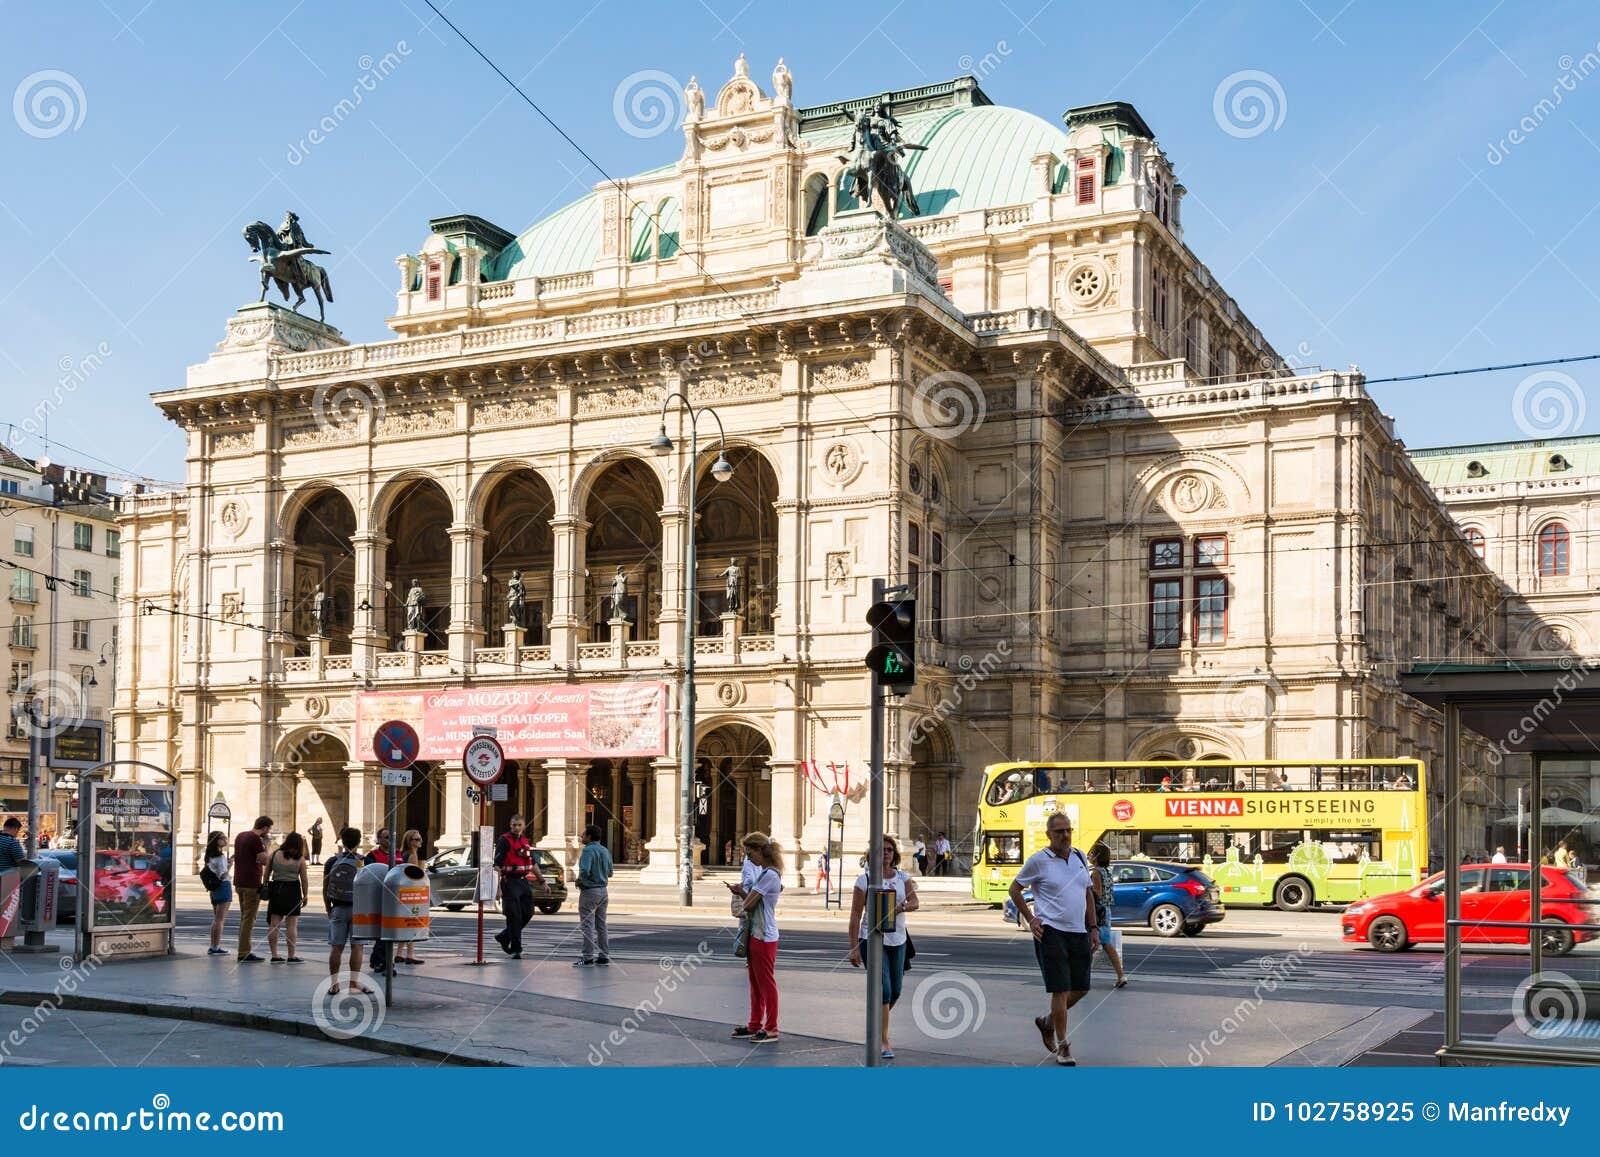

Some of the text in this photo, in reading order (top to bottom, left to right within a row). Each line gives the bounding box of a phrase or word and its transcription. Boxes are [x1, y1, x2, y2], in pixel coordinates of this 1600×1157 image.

[467, 692, 532, 706] MOZART
[458, 714, 500, 725] WIENER
[501, 712, 568, 725] STAATSOPER
[445, 730, 515, 741] MUSIEIN
[518, 730, 562, 740] Goldener
[563, 728, 586, 739] Saal
[469, 763, 497, 778] HALTESTELLE
[1168, 799, 1376, 816] VIENNA SIGHTSEEING
[1304, 817, 1335, 825] simply
